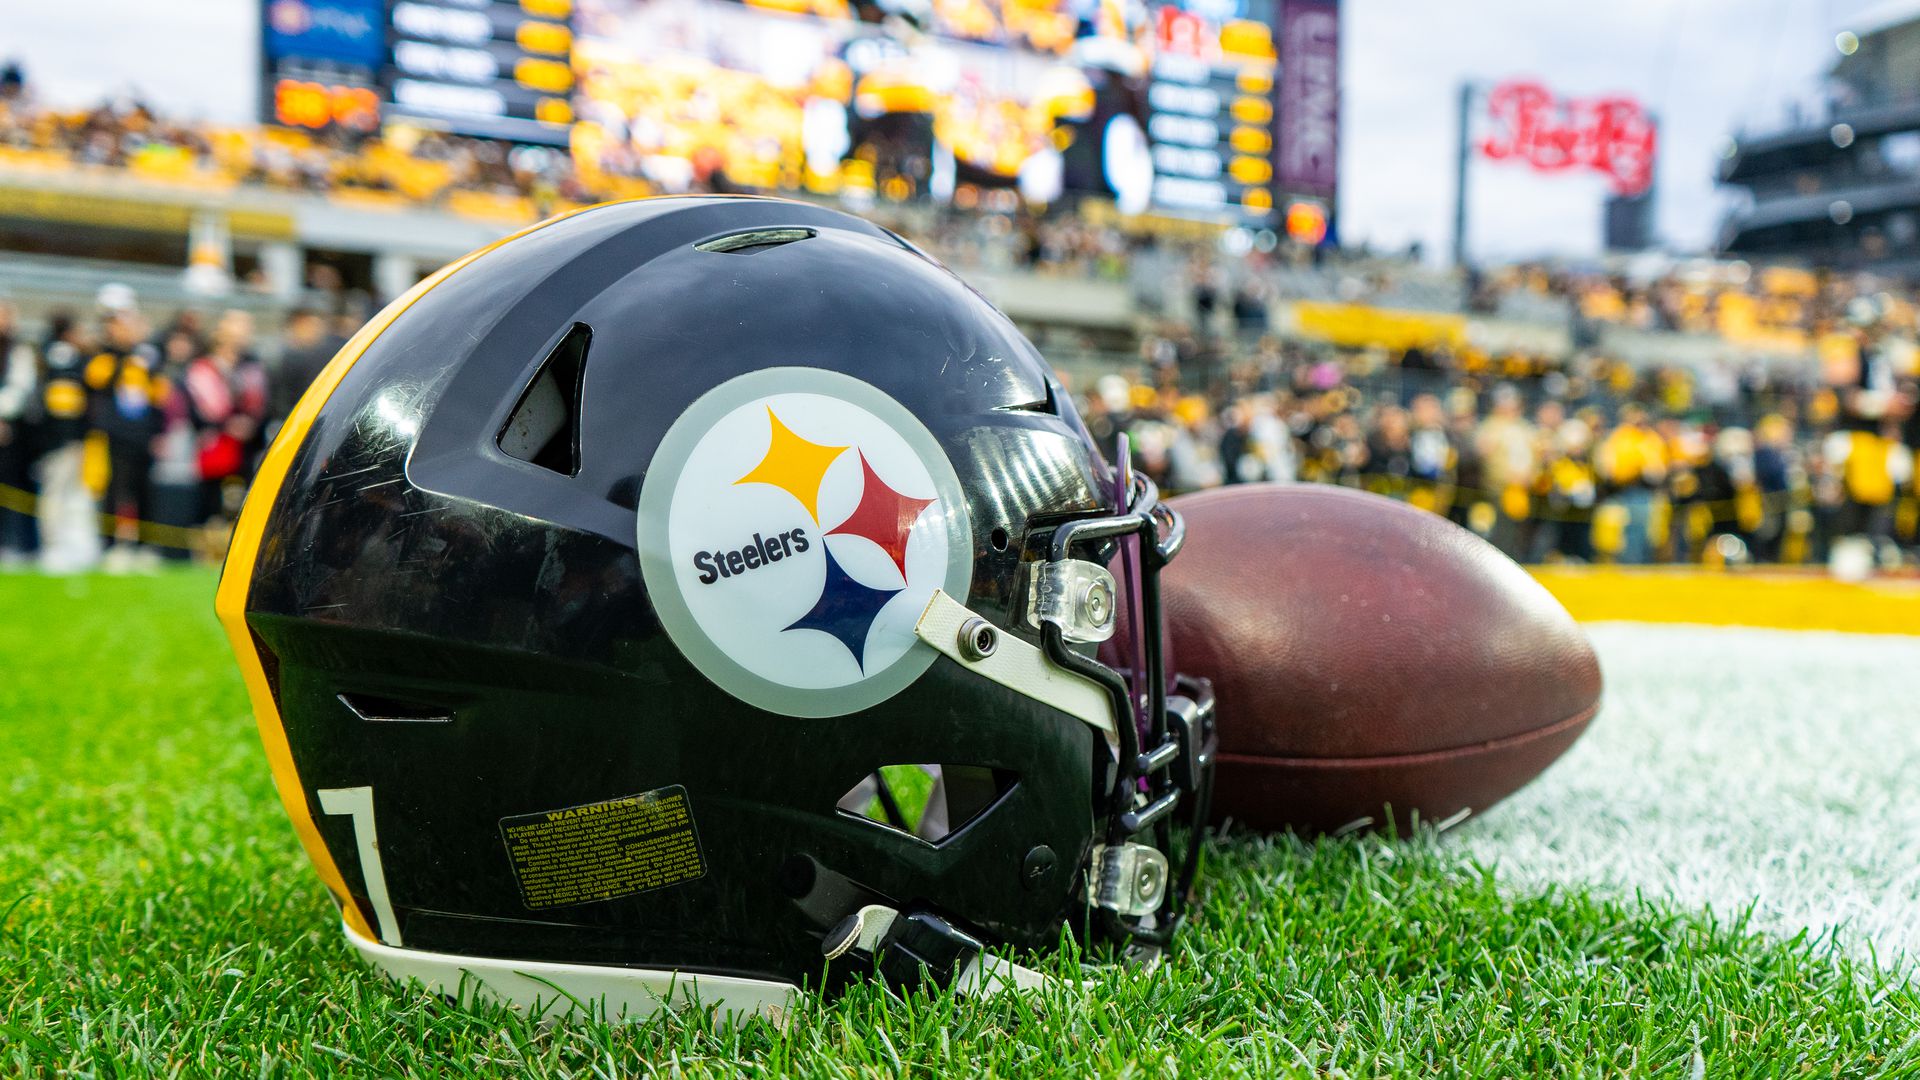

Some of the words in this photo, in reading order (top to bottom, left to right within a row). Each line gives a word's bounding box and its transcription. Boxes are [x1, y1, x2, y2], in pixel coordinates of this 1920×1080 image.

[693, 528, 810, 585] Steelers
[547, 798, 636, 821] WARNING
[317, 785, 403, 947] 7
